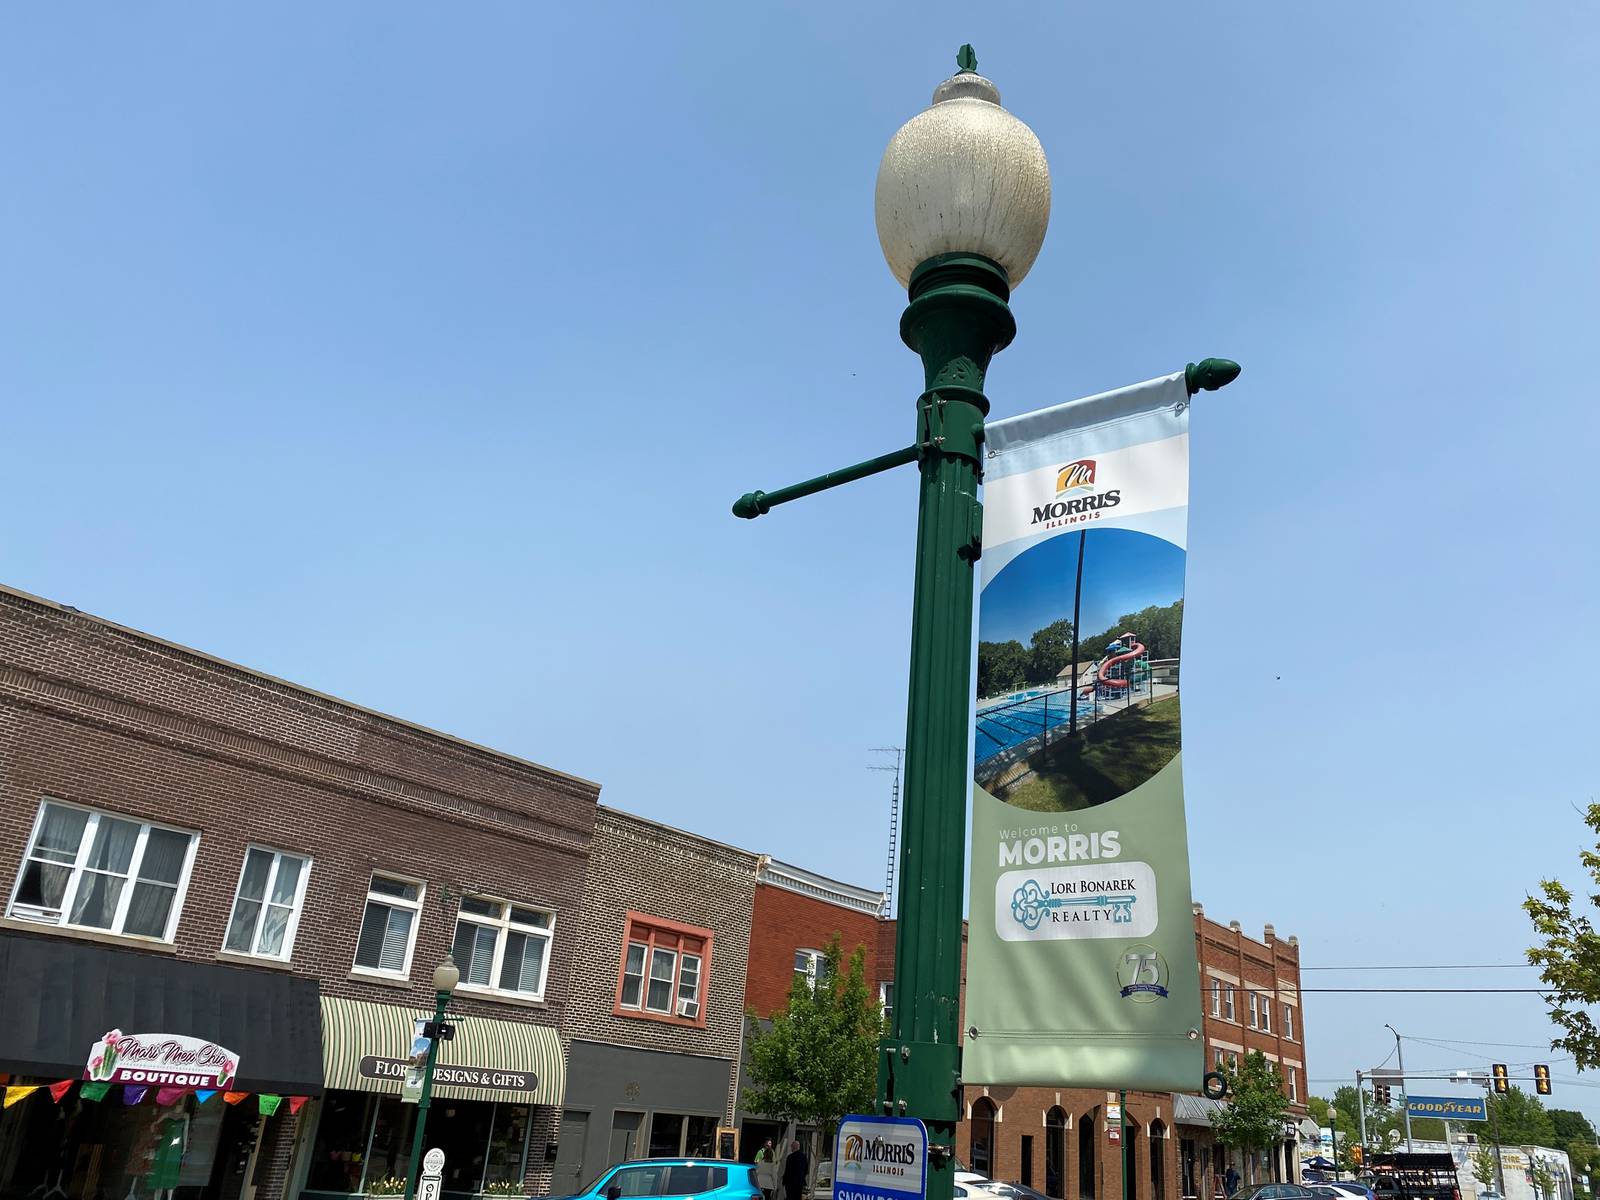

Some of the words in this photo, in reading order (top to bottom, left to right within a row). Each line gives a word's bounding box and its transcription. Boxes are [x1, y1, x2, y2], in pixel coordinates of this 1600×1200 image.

[1031, 490, 1121, 524] MORRIS
[1046, 511, 1101, 529] ILLINOIS
[1000, 824, 1058, 840] Welcome
[1064, 823, 1078, 833] to
[999, 830, 1122, 867] MORRIS
[1052, 909, 1112, 923] REALTY
[1126, 952, 1160, 985] 75
[120, 1070, 210, 1086] BOUTIQUE
[375, 1061, 407, 1077] FLOR
[480, 1074, 491, 1085] &
[492, 1073, 525, 1087] GIFTS
[1408, 1102, 1482, 1114] GOODYEAR
[864, 1139, 915, 1165] MORRIS
[873, 1165, 904, 1176] ILLINOIS
